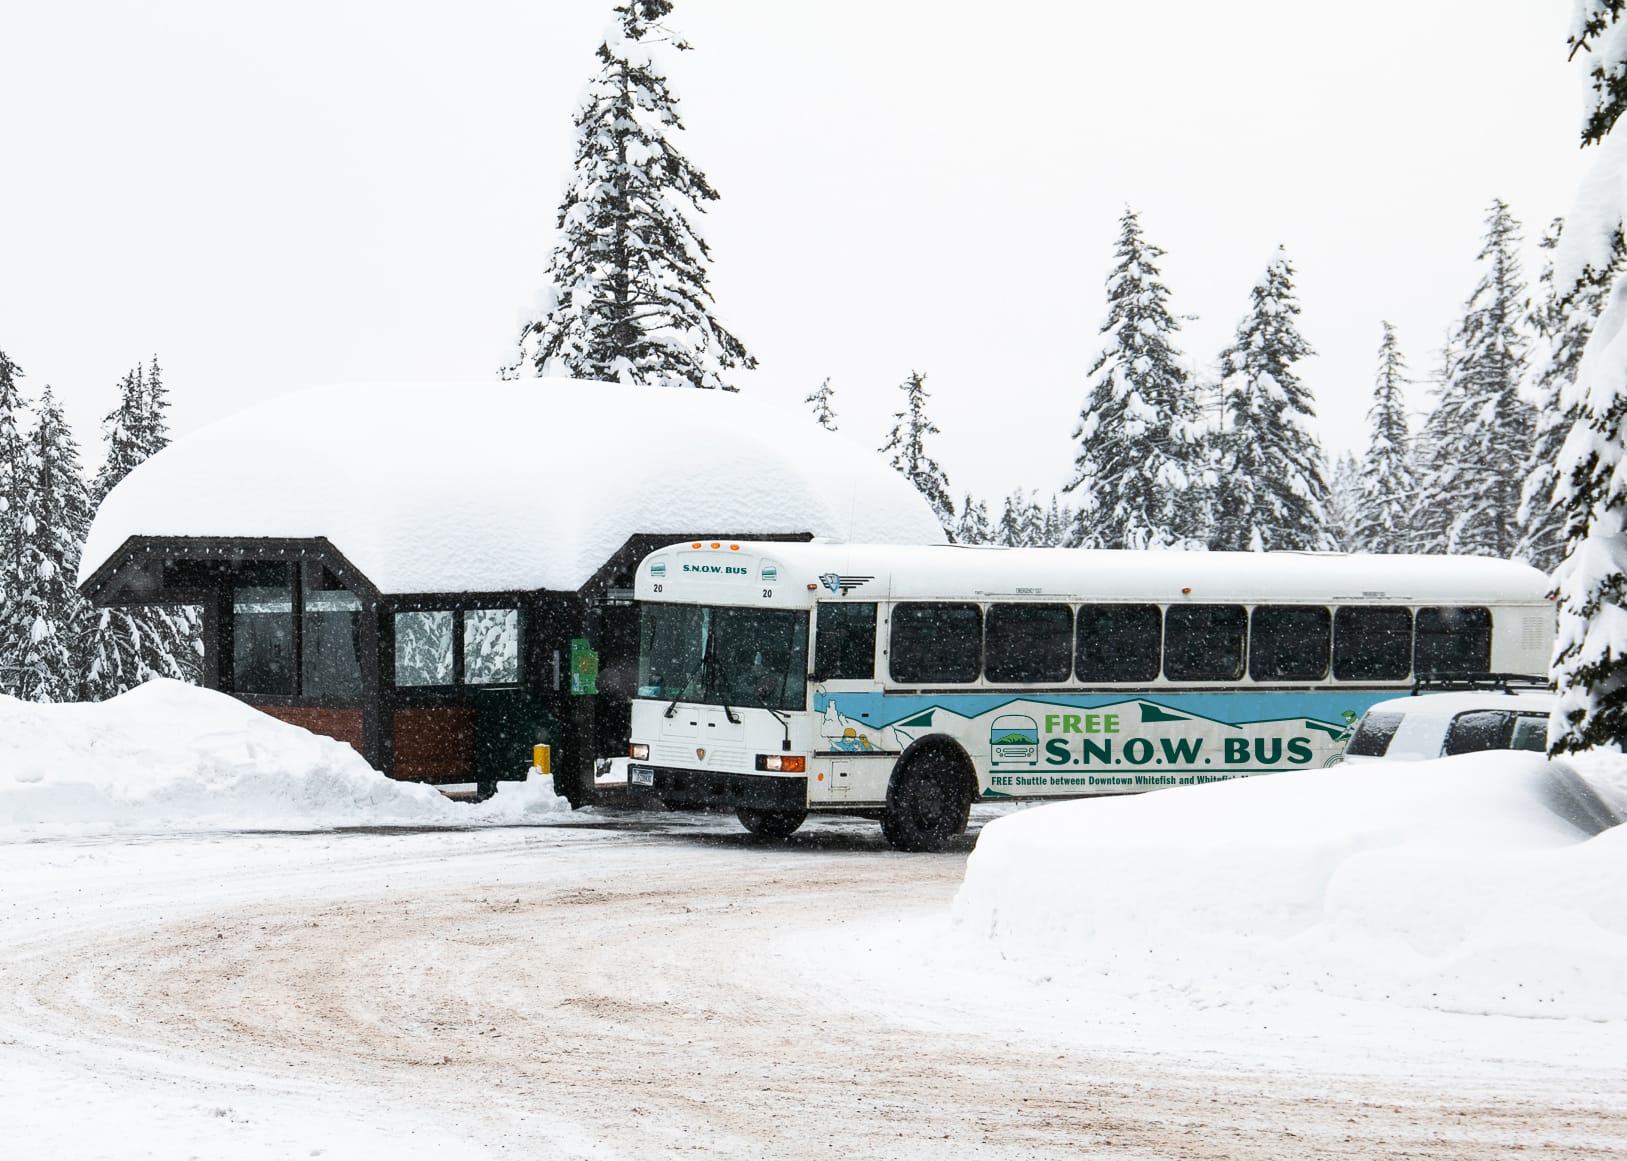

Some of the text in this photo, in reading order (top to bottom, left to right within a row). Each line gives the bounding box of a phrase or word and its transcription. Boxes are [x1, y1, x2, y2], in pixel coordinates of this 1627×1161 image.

[683, 564, 747, 574] S.N.O.W. BUS
[653, 583, 663, 593] 20
[762, 588, 773, 598] 20
[1045, 714, 1120, 733] FREE
[1045, 737, 1313, 765] S.N.O.W. BUS
[991, 776, 1013, 786] FREE
[1015, 776, 1047, 786] Shuttle
[1050, 776, 1086, 786] between
[1088, 775, 1133, 785] Downtown
[1135, 775, 1176, 785] Whitefish
[1178, 775, 1194, 785] and
